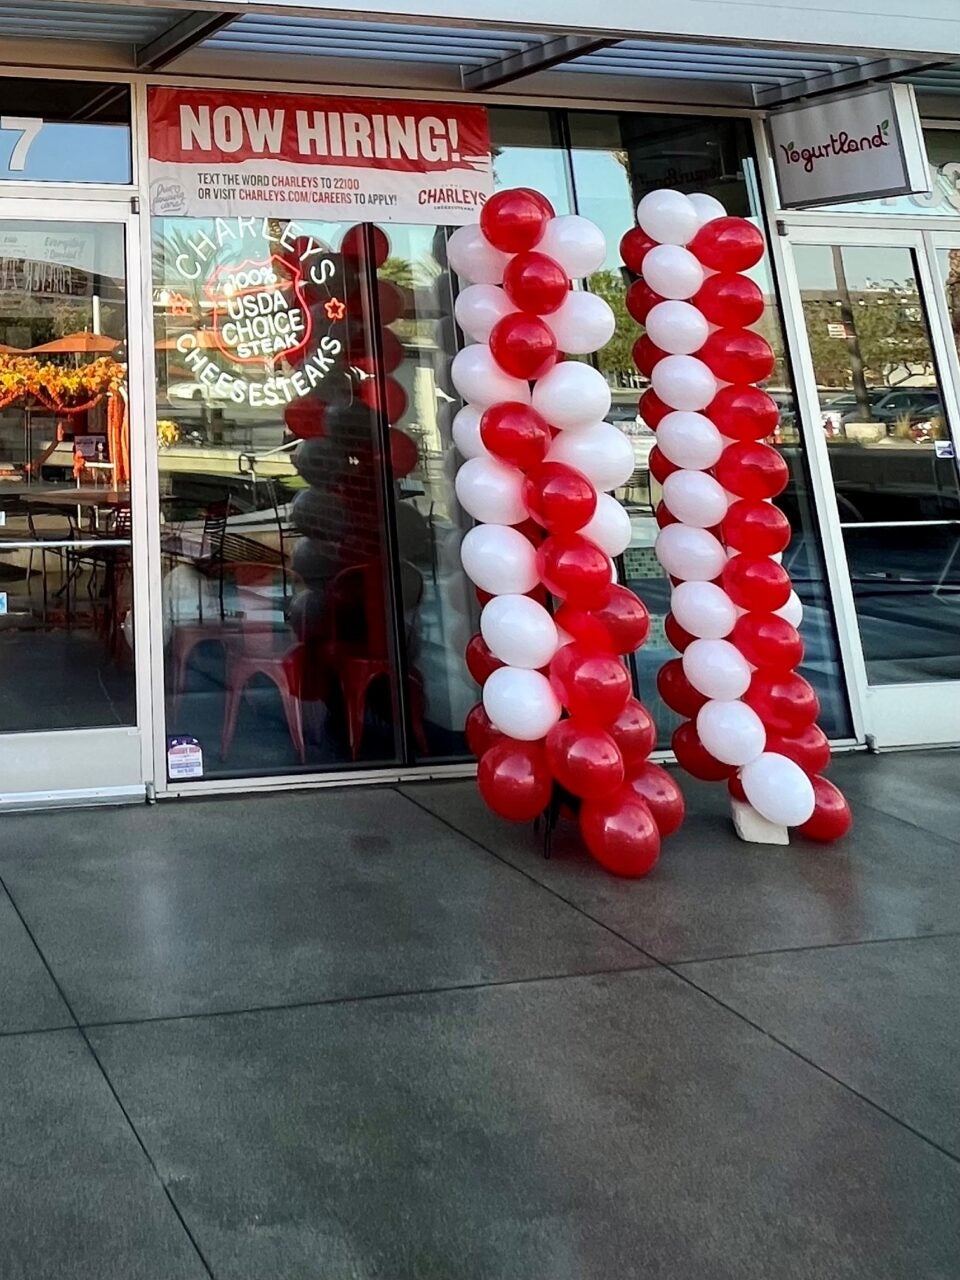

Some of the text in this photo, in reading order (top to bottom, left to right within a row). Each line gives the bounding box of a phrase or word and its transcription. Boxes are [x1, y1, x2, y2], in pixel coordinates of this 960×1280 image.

[179, 104, 460, 163] NOW HIRING!
[780, 124, 888, 172] Yogurtland
[197, 172, 360, 190] TEXT THE WORD CHARLEYS TO 22100
[197, 187, 397, 206] OR VISIT CHARLEYS.COM/CAREERS TO APPLY!
[418, 188, 487, 207] CHARLEYS
[175, 216, 336, 285] CHARLEYS
[227, 267, 278, 289] 100%
[227, 290, 289, 320] USDA
[221, 308, 305, 346] CHOICE
[236, 332, 301, 359] STEAK
[176, 333, 341, 407] CHEESESTEAKS
